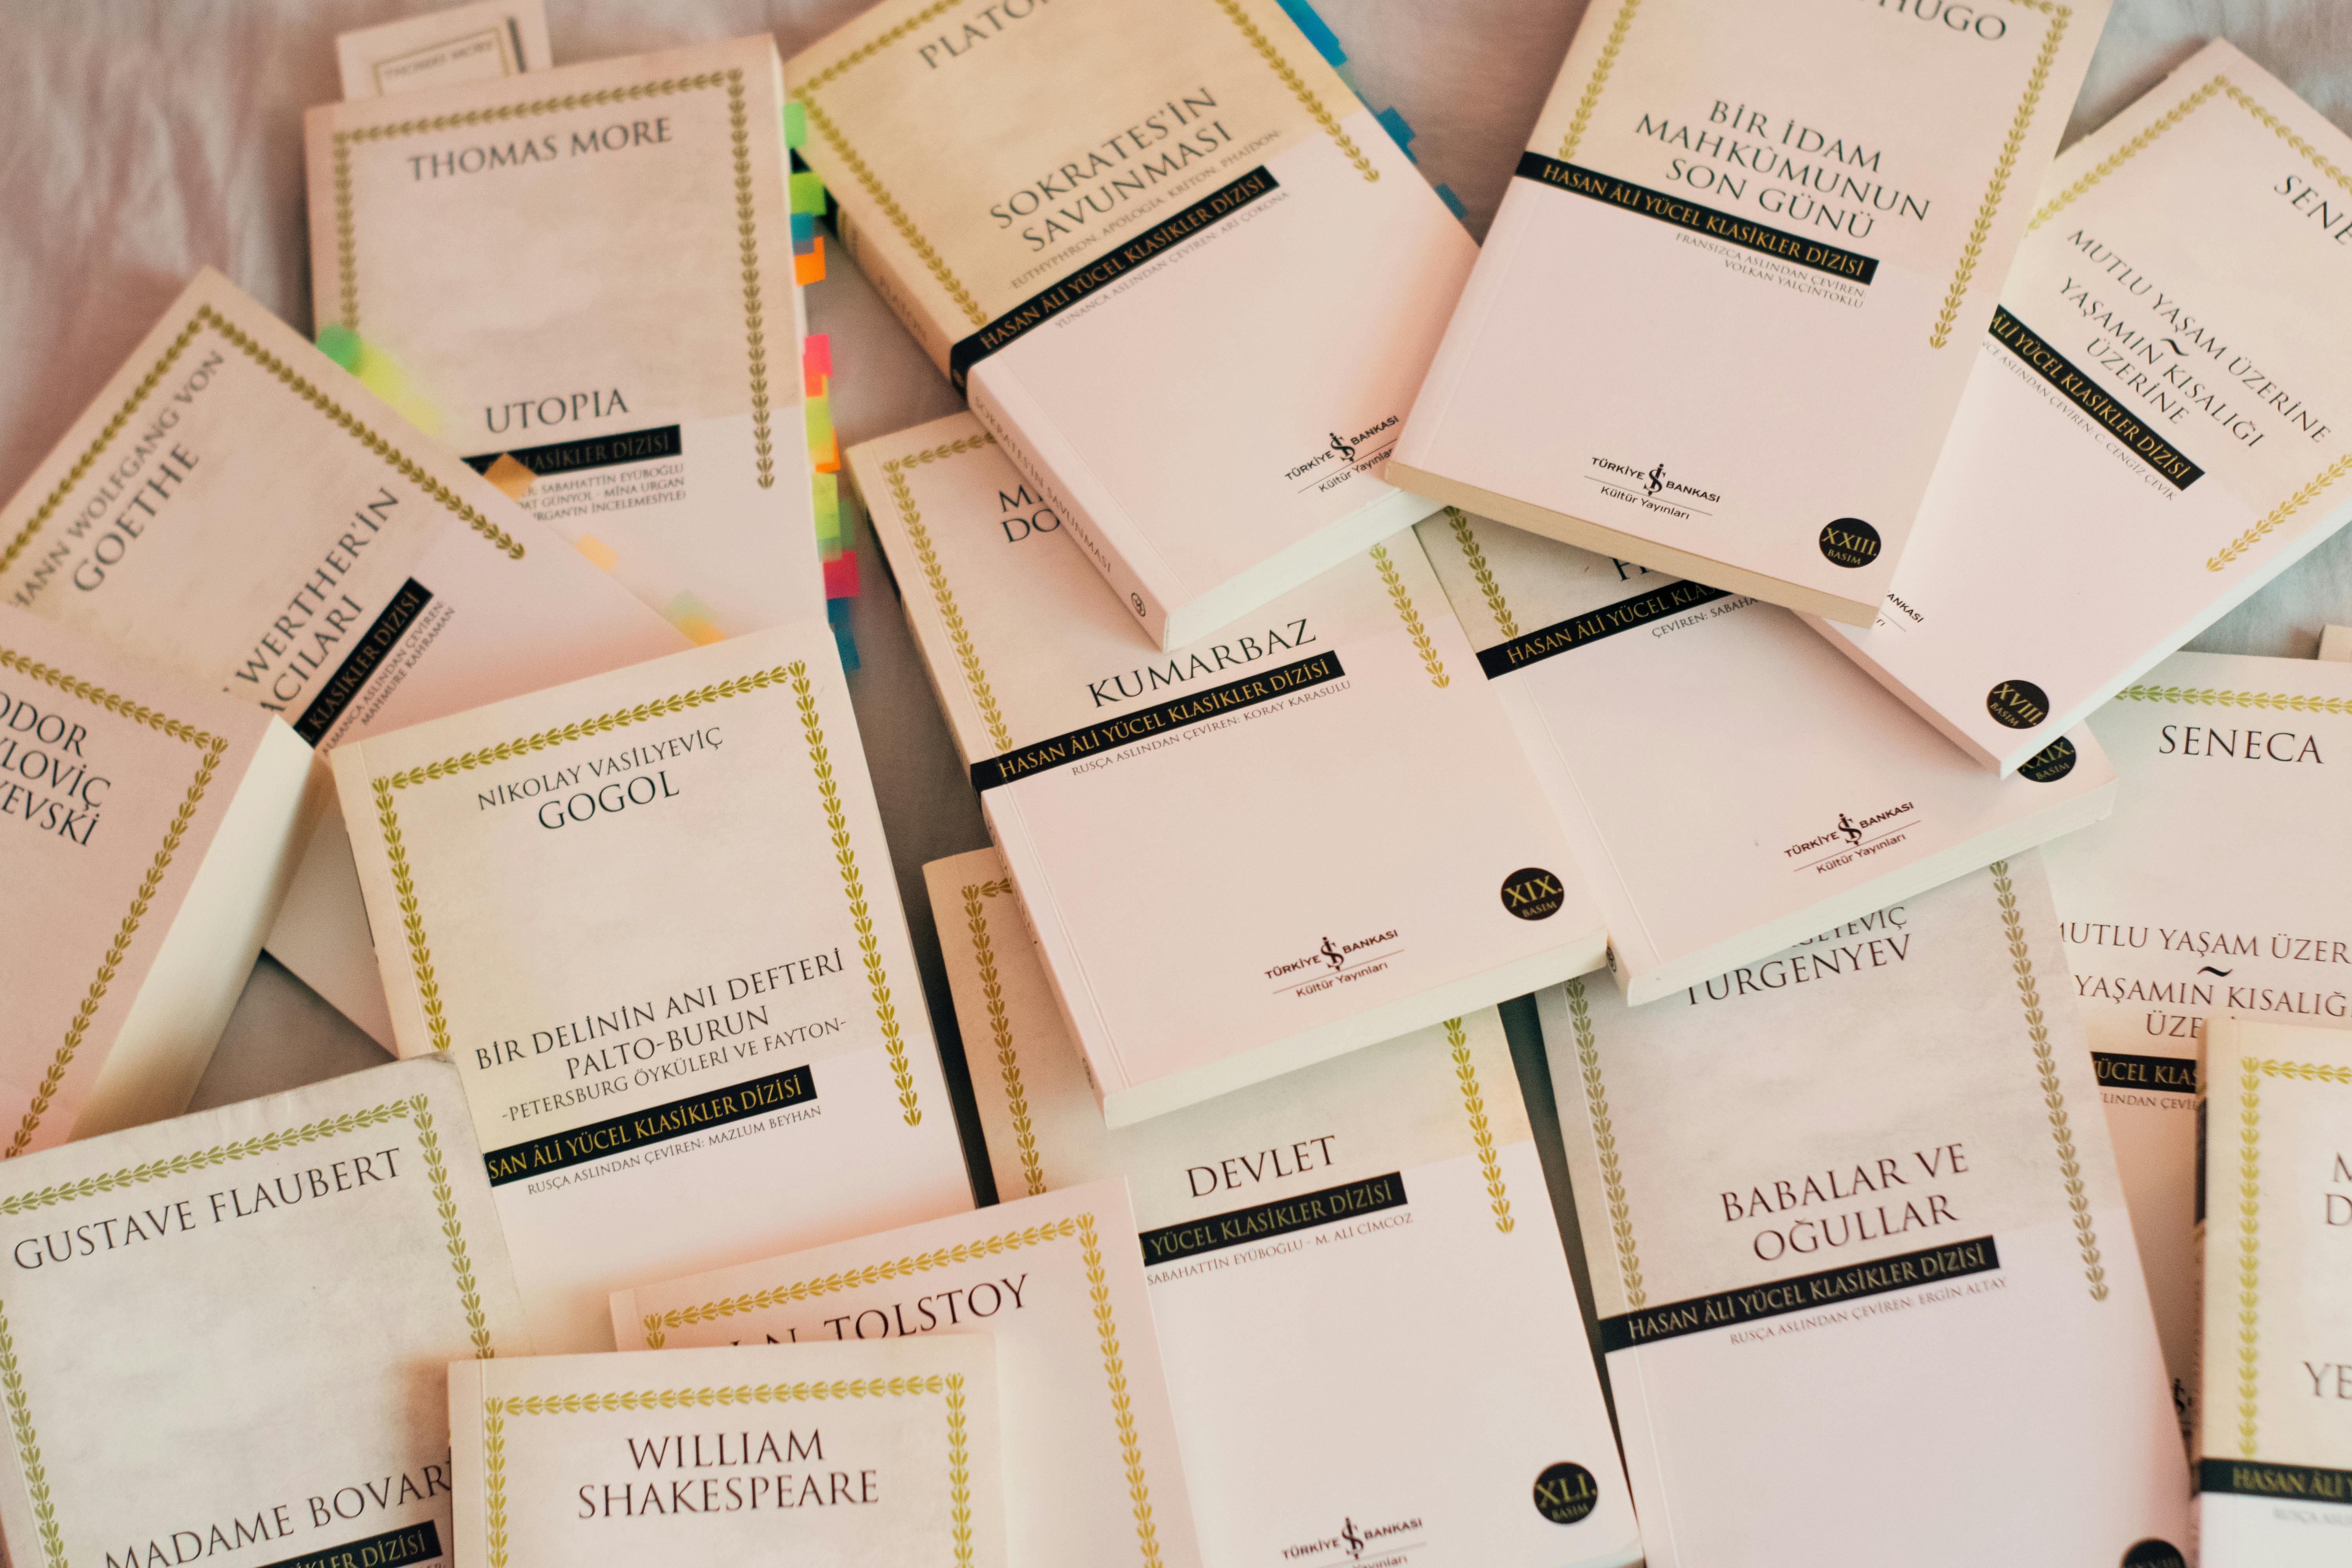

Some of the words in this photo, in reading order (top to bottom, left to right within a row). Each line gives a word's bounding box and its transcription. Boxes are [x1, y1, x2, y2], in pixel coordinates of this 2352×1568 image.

[407, 134, 558, 181] THOMAS
[570, 116, 671, 157] MORE
[989, 87, 1217, 229] SOKRATES'İN
[1635, 113, 1931, 221] MAHKÛMUNUN
[1709, 100, 1768, 138] BİR
[1781, 120, 1881, 173] İDAM
[1022, 120, 1232, 252] SAVUNMASI
[1666, 158, 1747, 200] SON
[1758, 189, 1875, 238] GÜNÜ
[1543, 164, 1608, 196] HASAN
[1609, 183, 1641, 206] ÂLİ
[1646, 195, 1700, 226] YÜCEL
[1706, 215, 1801, 258] KLASİKLER
[1805, 246, 1864, 276] DİZİSİ
[980, 306, 1041, 350] HASAN
[1067, 258, 1125, 294] YÜCEL
[1123, 208, 1213, 263] KLASİKLER
[1210, 175, 1265, 214] DİZİSİ
[2060, 277, 2164, 365] YAŞAMIN
[2162, 363, 2265, 448] KISALIĞI
[2068, 230, 2153, 295] MUTLU
[2152, 292, 2227, 361] YAŞAM
[2227, 356, 2331, 443] ÜZERİNE
[485, 388, 629, 434] UTOPIA
[2014, 332, 2063, 378] YÜCEL
[2060, 372, 2140, 441] KLASİKLER
[2136, 435, 2192, 479] DİZİSİ
[2086, 337, 2189, 424] ÜZERİNE
[65, 407, 180, 539] WOLFGANG
[172, 350, 225, 404] VON
[1350, 415, 1399, 446] BANKASI
[1284, 450, 1335, 481] TÜRKİYE
[1318, 471, 1352, 493] Kültür
[1592, 457, 1646, 480] TÜRKİYE
[1665, 480, 1721, 503] BANKASI
[72, 443, 199, 592] GOETHE
[1600, 486, 1638, 503] Kültür
[1641, 498, 1690, 520] Yayınları
[1822, 528, 1877, 556] XXIII.
[1827, 548, 1862, 565] BASIM
[234, 486, 399, 684] WERTHER'İN
[1506, 628, 1573, 664] HASAN
[1577, 614, 1606, 640] ÂLİ
[1606, 597, 1669, 626] YÜCEL
[1651, 612, 1708, 639] ÇEVİREN:
[309, 645, 380, 730] KLASİKLER
[373, 591, 420, 646] DİZİSİ
[1087, 618, 1317, 708] KUMARBAZ
[998, 742, 1066, 779] HASAN
[1072, 730, 1100, 755] ÂLİ
[1102, 713, 1166, 742] YÜCEL
[1167, 681, 1269, 723] KLASİKLER
[1269, 658, 1330, 691] DİZİSİ
[1071, 756, 1114, 776] RUSÇA
[1116, 734, 1180, 762] ASLINDAN
[1182, 716, 1241, 741] ÇEVİREN:
[1243, 701, 1284, 722] KORAY
[1287, 680, 1351, 707] KARASULU
[1989, 702, 2020, 727] BASIM
[1994, 683, 2043, 726] XVIII.
[477, 765, 581, 811] NİKOLAY
[587, 726, 723, 777] VASİLYEVİÇ
[2159, 724, 2323, 764] SENECA
[538, 770, 680, 830] GOGOL
[1859, 802, 1914, 829] BANKASI
[1784, 831, 1840, 858] TÜRKİYE
[1816, 854, 1853, 874] Kültür
[1854, 834, 1906, 858] Yayınları
[1504, 875, 1563, 908] XIX.
[1264, 955, 1322, 979] TÜRKİYE
[1342, 929, 1399, 954] BANKASI
[2159, 928, 2259, 958] YAŞAM
[475, 1039, 526, 1070] BİR
[531, 1001, 655, 1054] DELİNİN
[666, 985, 717, 1019] ANI
[727, 947, 844, 1001] DEFTERİ
[1295, 979, 1334, 998] Kültür
[1335, 962, 1388, 984] Yayınları
[2074, 974, 2214, 1006] YAŞAMIN
[502, 1075, 628, 1122] -PETERSBURG
[633, 1046, 729, 1087] ÖYKÜLERİ
[733, 1040, 759, 1059] VE
[763, 1017, 846, 1052] FAYTON-
[566, 1005, 769, 1080] PALTO-BURUN
[527, 1175, 571, 1195] RUSÇA
[573, 1154, 641, 1183] ASLINDAN
[644, 1138, 705, 1165] ÇEVİREN:
[708, 1121, 766, 1146] MAZLUM
[768, 1105, 822, 1129] BEYHAN
[534, 1140, 563, 1167] ÂLİ
[565, 1125, 631, 1157] YÜCEL
[634, 1096, 739, 1139] KLASİKLER
[740, 1074, 802, 1110] DİZİSİ
[1186, 1134, 1335, 1198] DEVLET
[1720, 1158, 1908, 1222] BABALAR
[1914, 1143, 1968, 1178] VE
[13, 1200, 196, 1270] GUSTAVE
[208, 1147, 400, 1223] FLAUBERT
[1150, 1225, 1217, 1256] YÜCEL
[1220, 1200, 1328, 1241] KLASİKLER
[1329, 1179, 1393, 1215] DİZİSİ
[1753, 1194, 1958, 1261] OĞULLAR
[1628, 1306, 1699, 1340] HASAN
[1704, 1296, 1736, 1323] ÂLİ
[1738, 1284, 1806, 1315] YÜCEL
[1809, 1261, 1918, 1300] KLASİKLER
[1920, 1243, 1986, 1277] DİZİSİ
[627, 1428, 824, 1470] WILLIAM
[579, 1470, 878, 1519] SHAKESPEARE
[105, 1504, 294, 1568] MADAME
[361, 1530, 426, 1568] DİZİSİ
